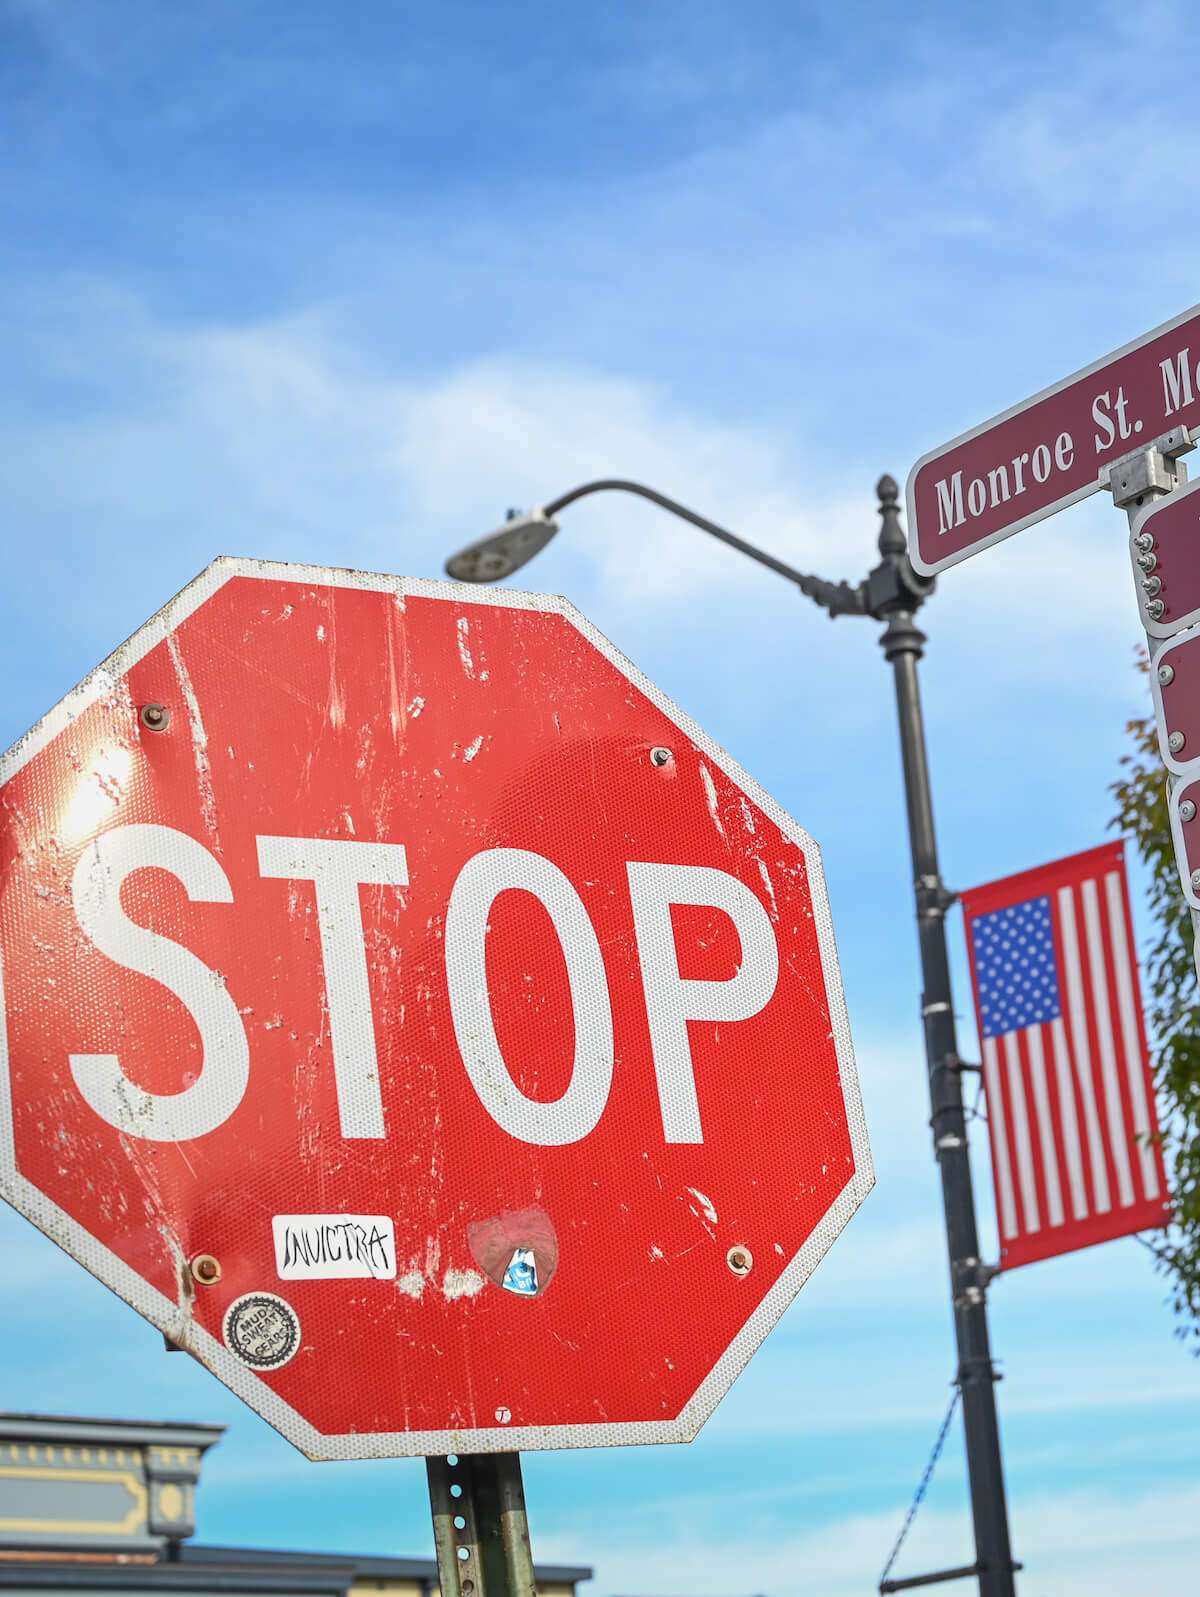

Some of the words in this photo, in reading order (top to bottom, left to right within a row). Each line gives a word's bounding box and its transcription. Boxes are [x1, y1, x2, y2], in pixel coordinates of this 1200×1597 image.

[934, 431, 1074, 536] Monroe
[1091, 386, 1143, 454] St.
[68, 822, 780, 1147] STOP
[240, 1309, 267, 1332] MUD
